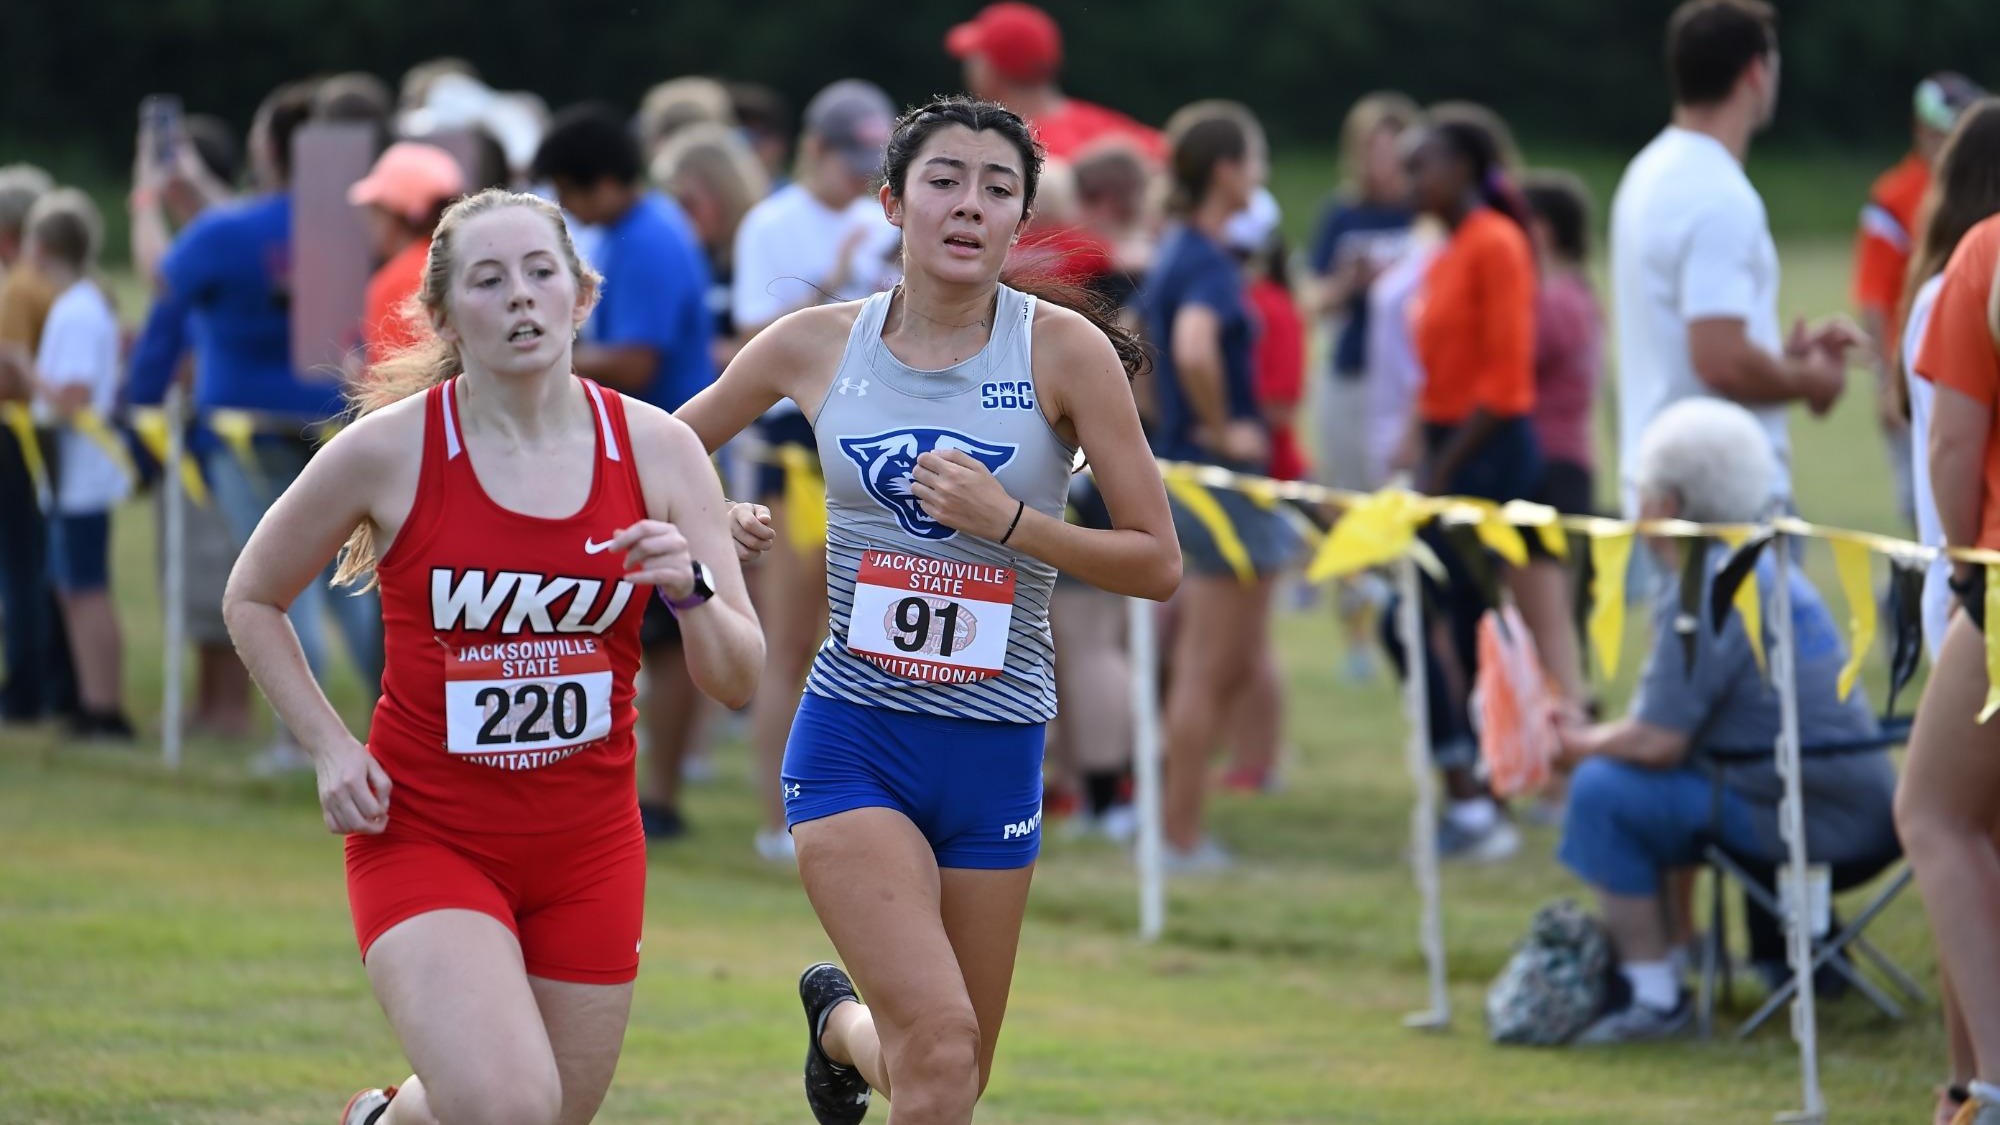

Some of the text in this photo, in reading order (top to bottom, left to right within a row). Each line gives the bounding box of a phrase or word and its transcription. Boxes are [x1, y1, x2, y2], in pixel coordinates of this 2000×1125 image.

[981, 381, 1034, 410] SBC
[873, 553, 1004, 584] JACKSONVILLE
[909, 572, 964, 595] STATE
[431, 567, 634, 634] WKU
[894, 597, 959, 657] 91
[458, 638, 596, 662] JACKSONVILLE
[502, 658, 560, 677] STATE
[474, 681, 588, 745] 220
